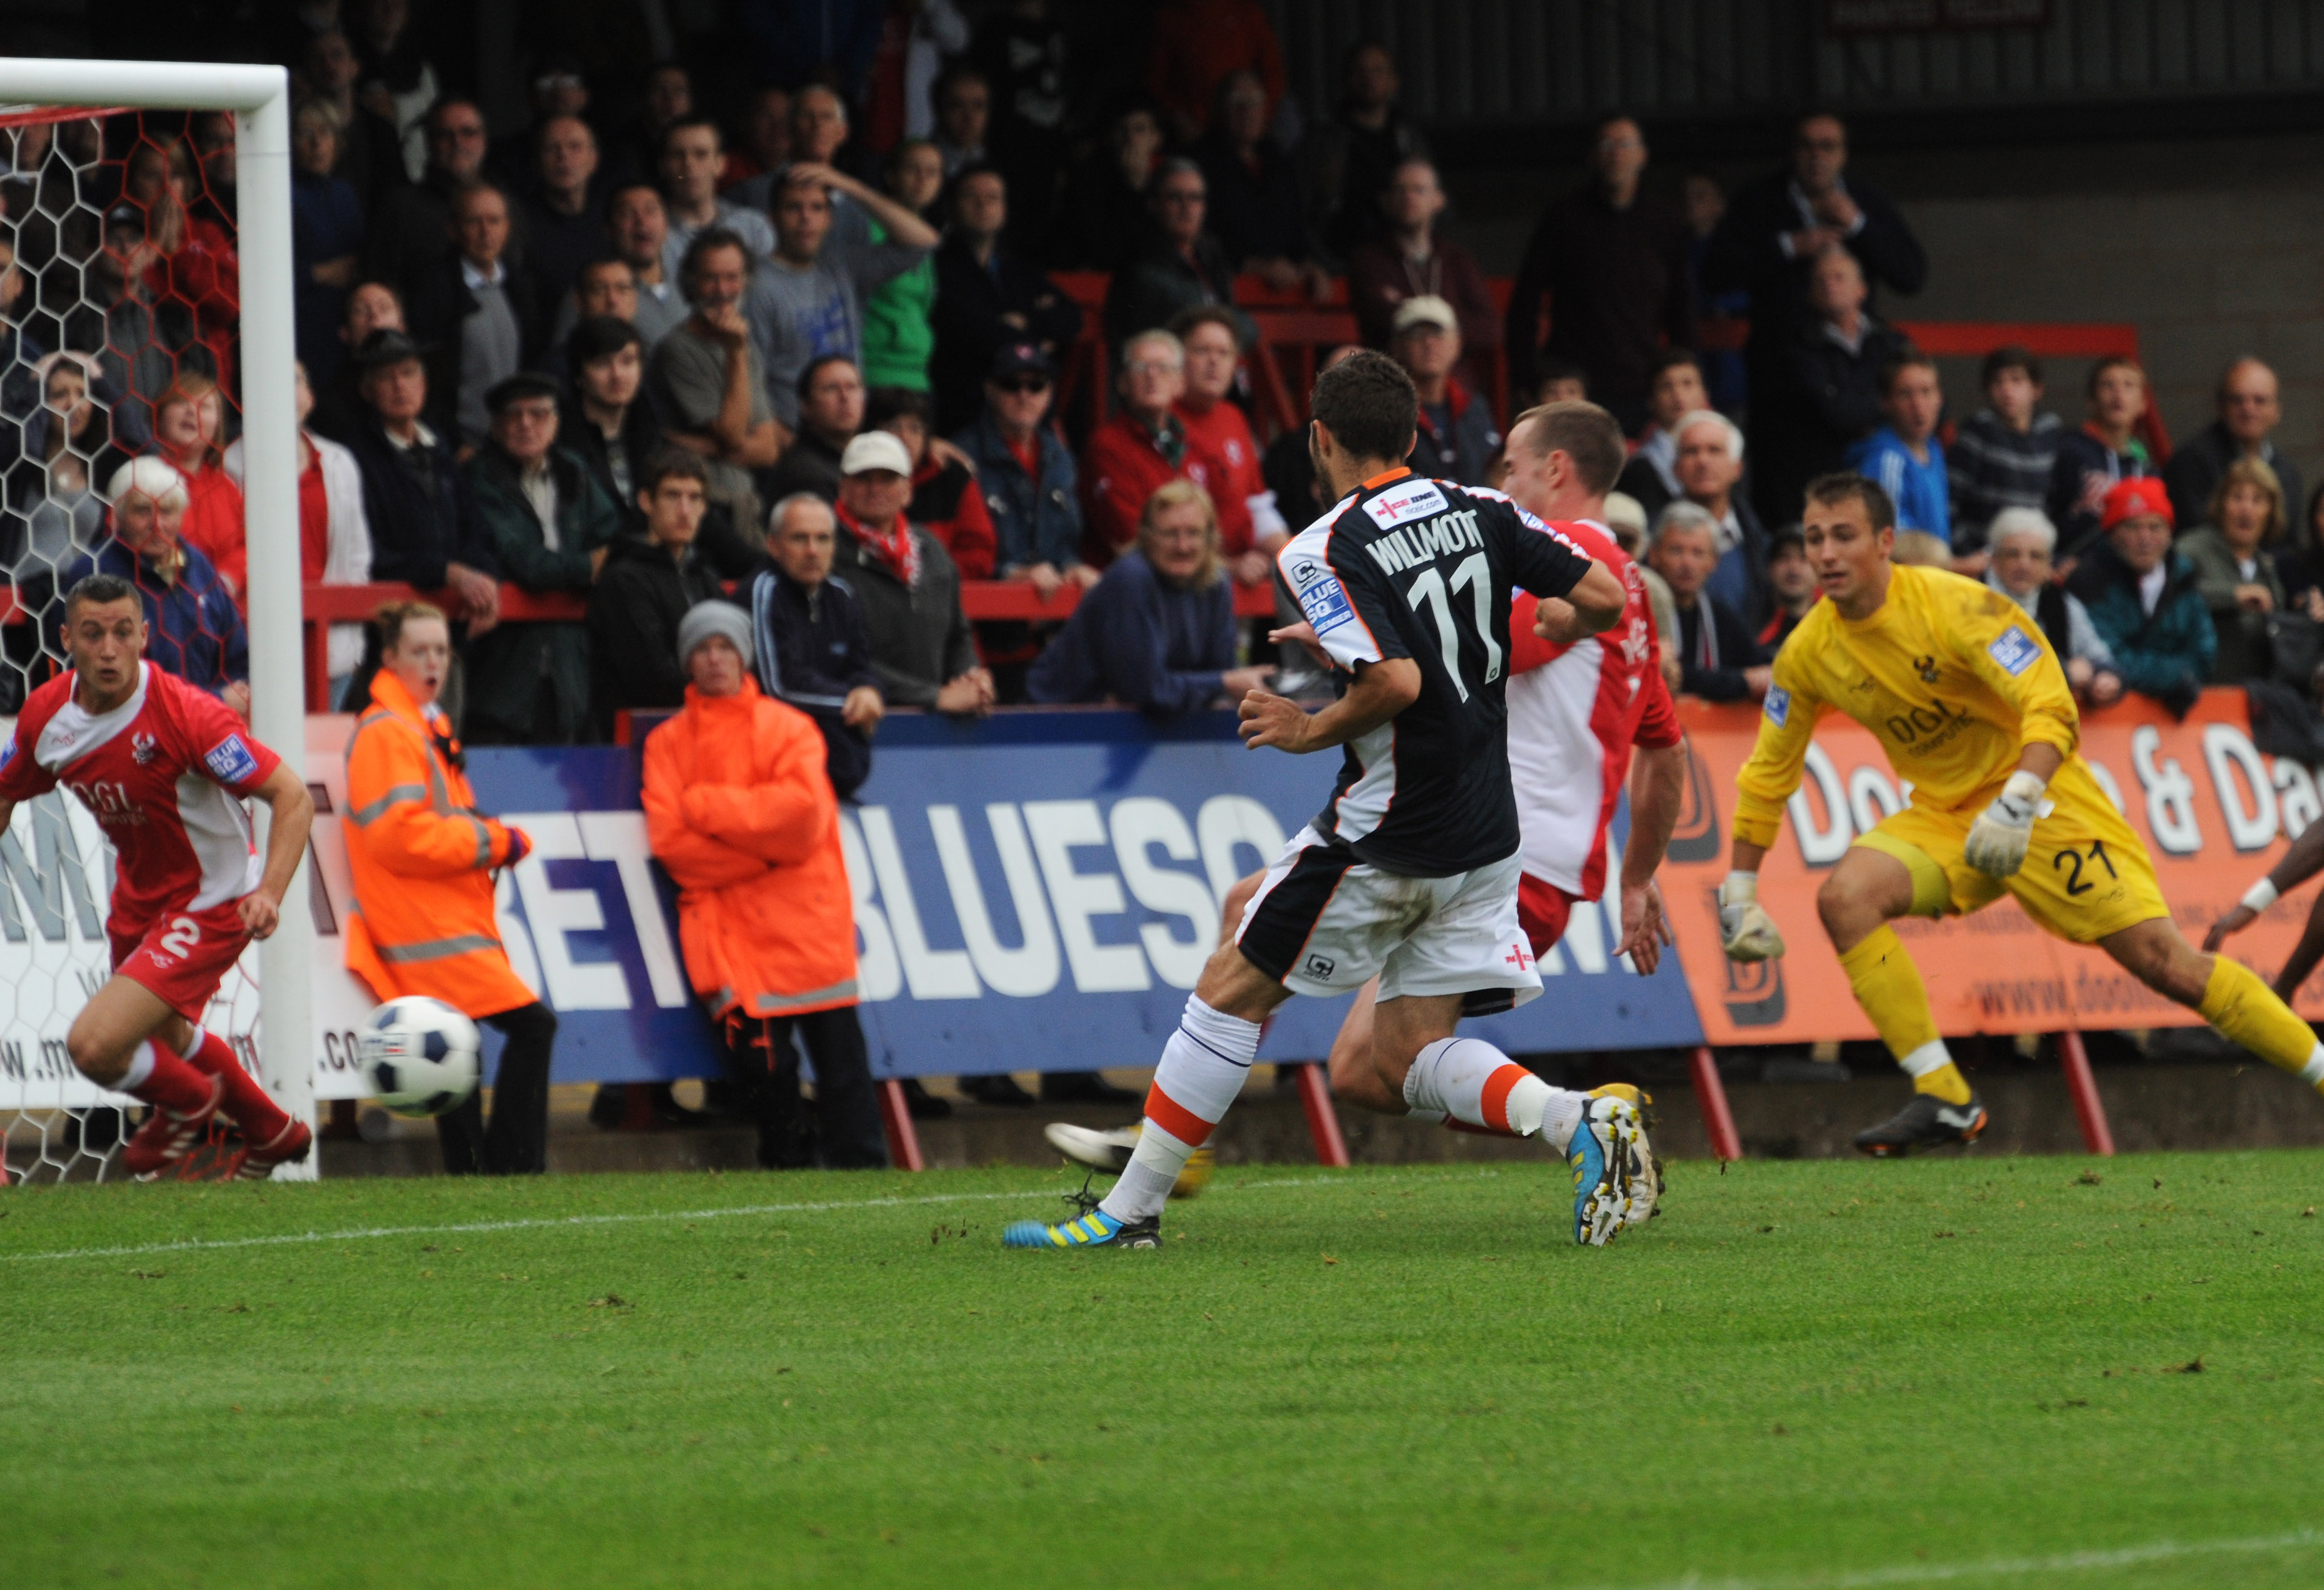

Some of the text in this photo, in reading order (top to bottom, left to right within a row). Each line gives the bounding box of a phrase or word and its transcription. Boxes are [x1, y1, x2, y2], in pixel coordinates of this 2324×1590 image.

[1365, 509, 1484, 576] WILLMOTT
[1300, 578, 1340, 612] BLUE
[1306, 600, 1334, 624] SQ
[1407, 551, 1502, 704] 11
[207, 738, 241, 768] BLUE
[214, 757, 238, 777] SQ
[2132, 724, 2203, 855] &
[2203, 722, 2324, 856] Da
[2053, 839, 2117, 896] 21
[161, 917, 200, 959] 2
